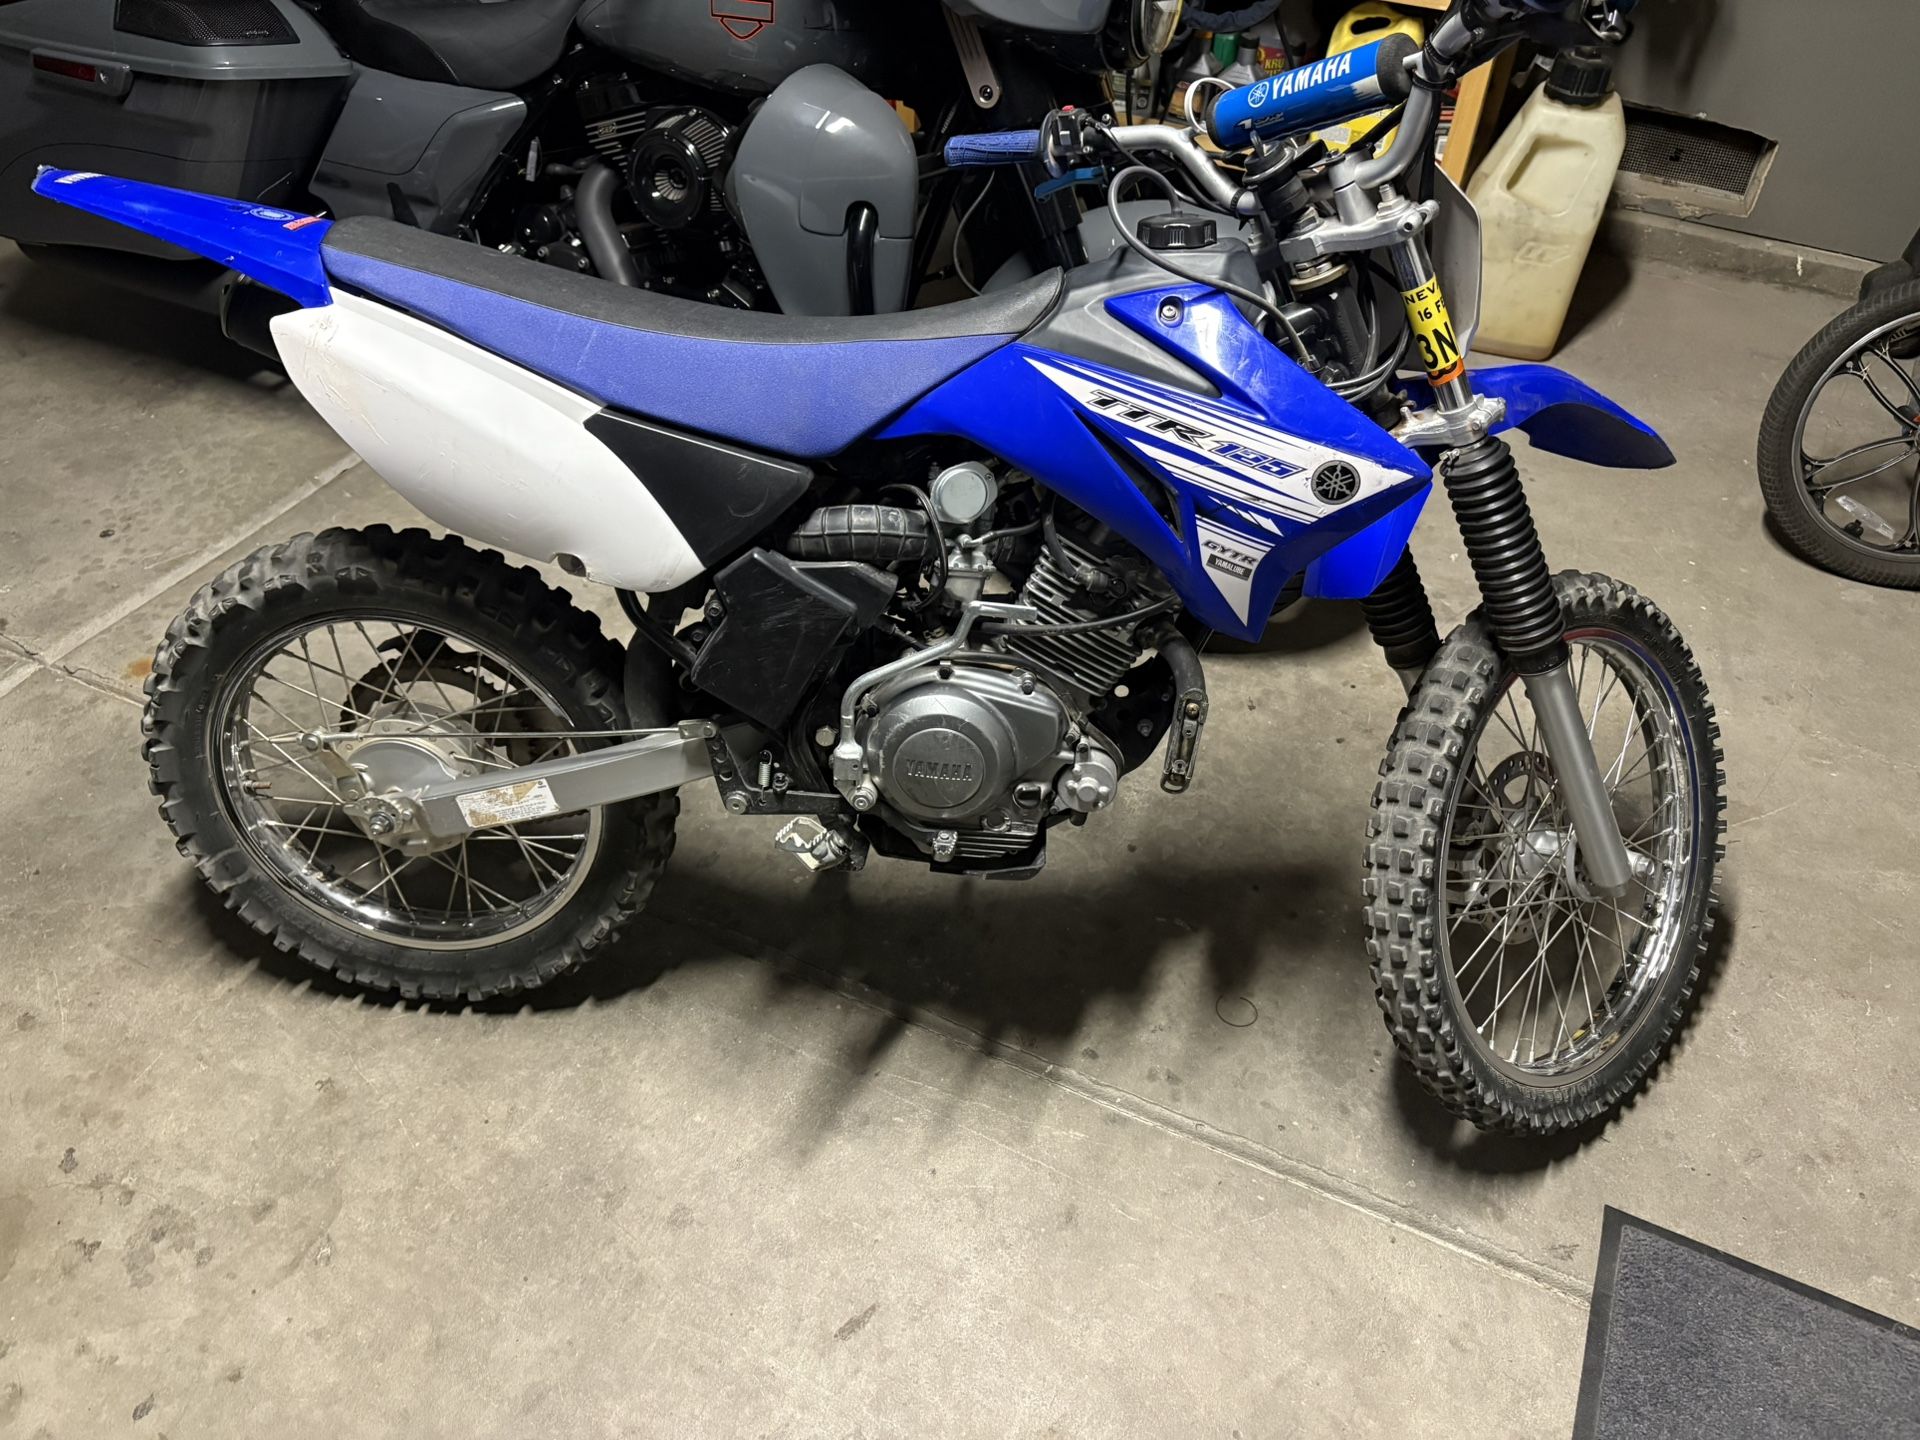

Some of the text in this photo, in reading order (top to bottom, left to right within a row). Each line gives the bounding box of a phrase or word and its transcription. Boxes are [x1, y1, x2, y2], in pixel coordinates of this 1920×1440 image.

[1272, 52, 1352, 100] YAMAHA
[1417, 307, 1433, 322] 16
[1416, 320, 1459, 370] 3N
[1201, 539, 1259, 566] GYTR
[1214, 558, 1246, 576] YAMALUBE
[905, 759, 973, 782] YAMAHA
